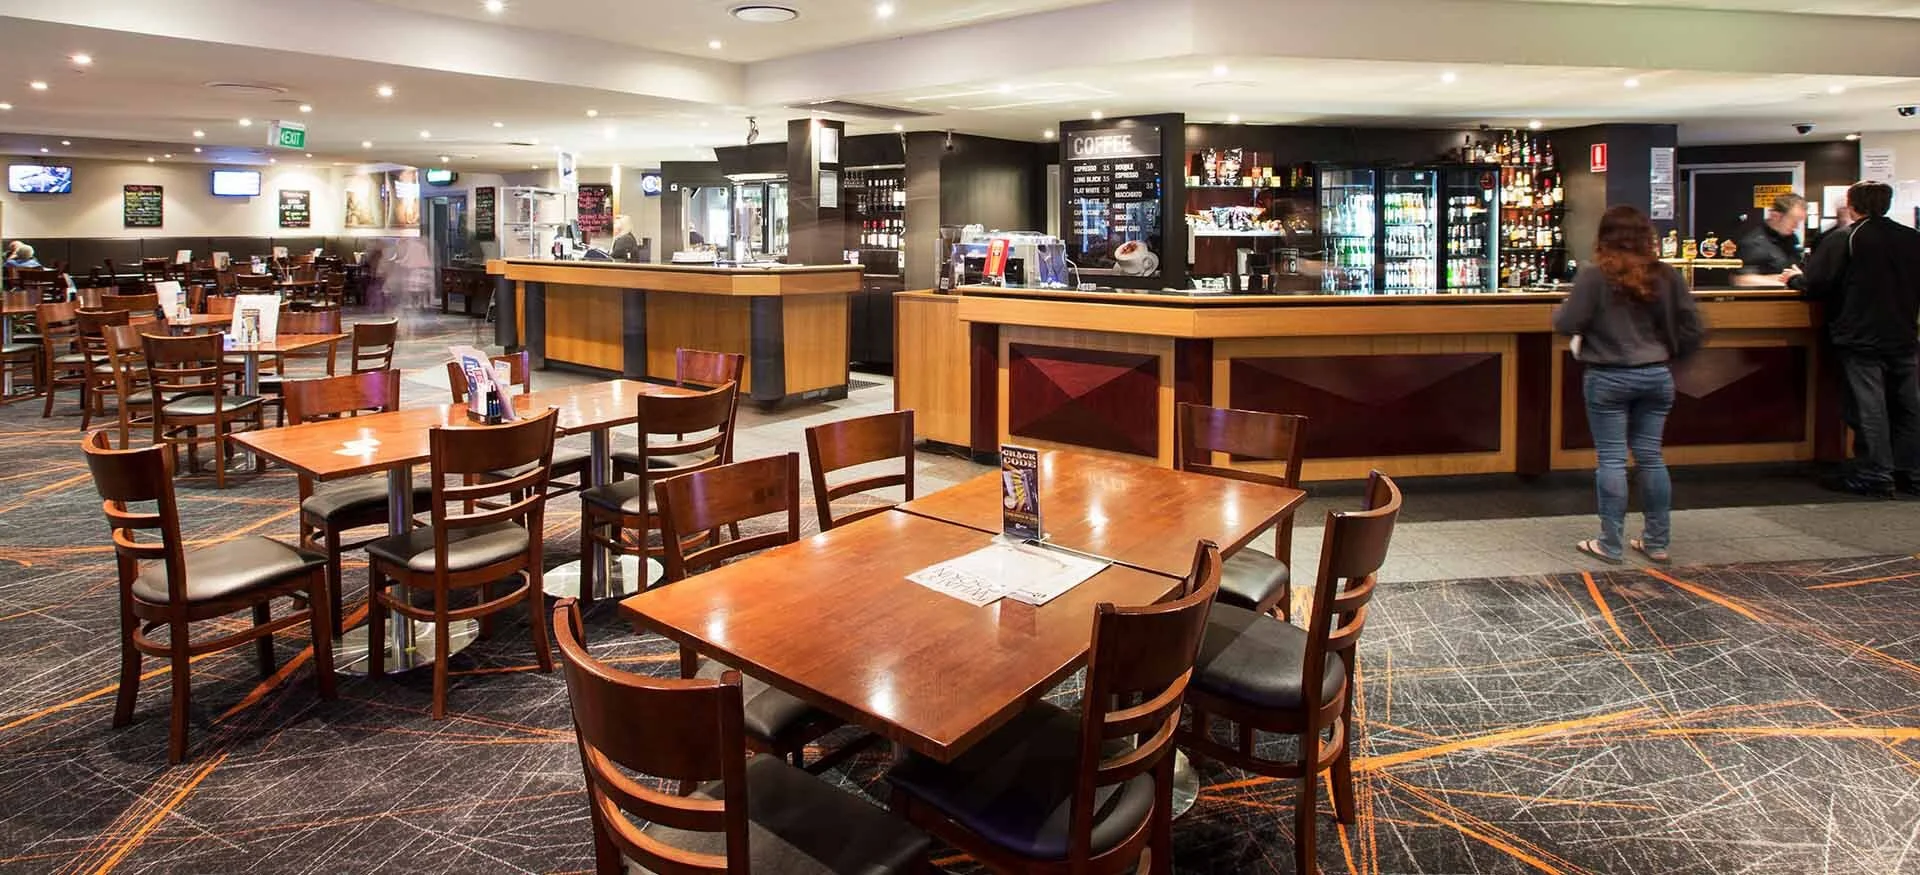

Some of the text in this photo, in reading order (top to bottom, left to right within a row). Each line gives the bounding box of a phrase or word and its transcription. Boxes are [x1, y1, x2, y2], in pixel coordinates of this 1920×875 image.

[284, 130, 301, 145] EXIT
[1074, 135, 1132, 154] COFFEE
[1114, 163, 1134, 171] DOUBLE
[1086, 175, 1102, 183] BLACK
[1114, 171, 1139, 179] ESPRESSO
[1001, 449, 1036, 460] CRACK
